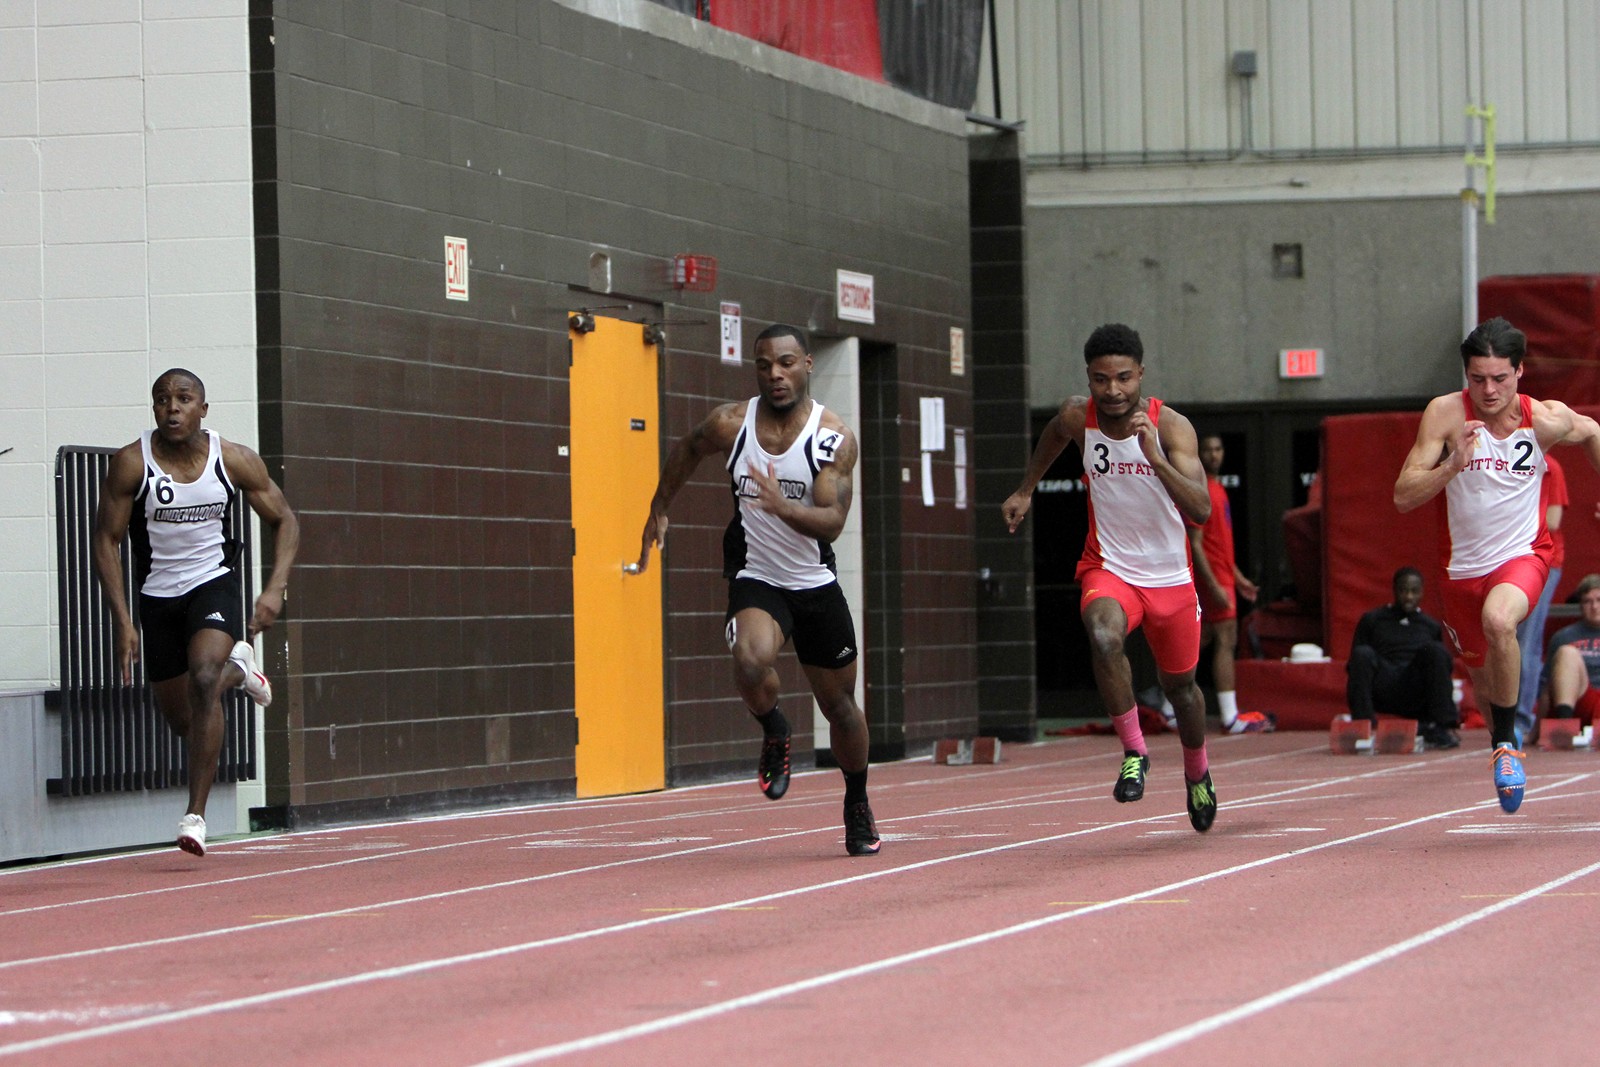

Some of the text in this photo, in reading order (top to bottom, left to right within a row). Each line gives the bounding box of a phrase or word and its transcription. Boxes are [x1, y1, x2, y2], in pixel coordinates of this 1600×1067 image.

[447, 242, 465, 285] EXIT
[818, 433, 839, 457] 4
[1094, 443, 1110, 474] 3
[1511, 440, 1534, 471] 2
[1118, 461, 1156, 477] STAT
[155, 476, 175, 505] 6
[156, 503, 224, 522] LINDENWOOD
